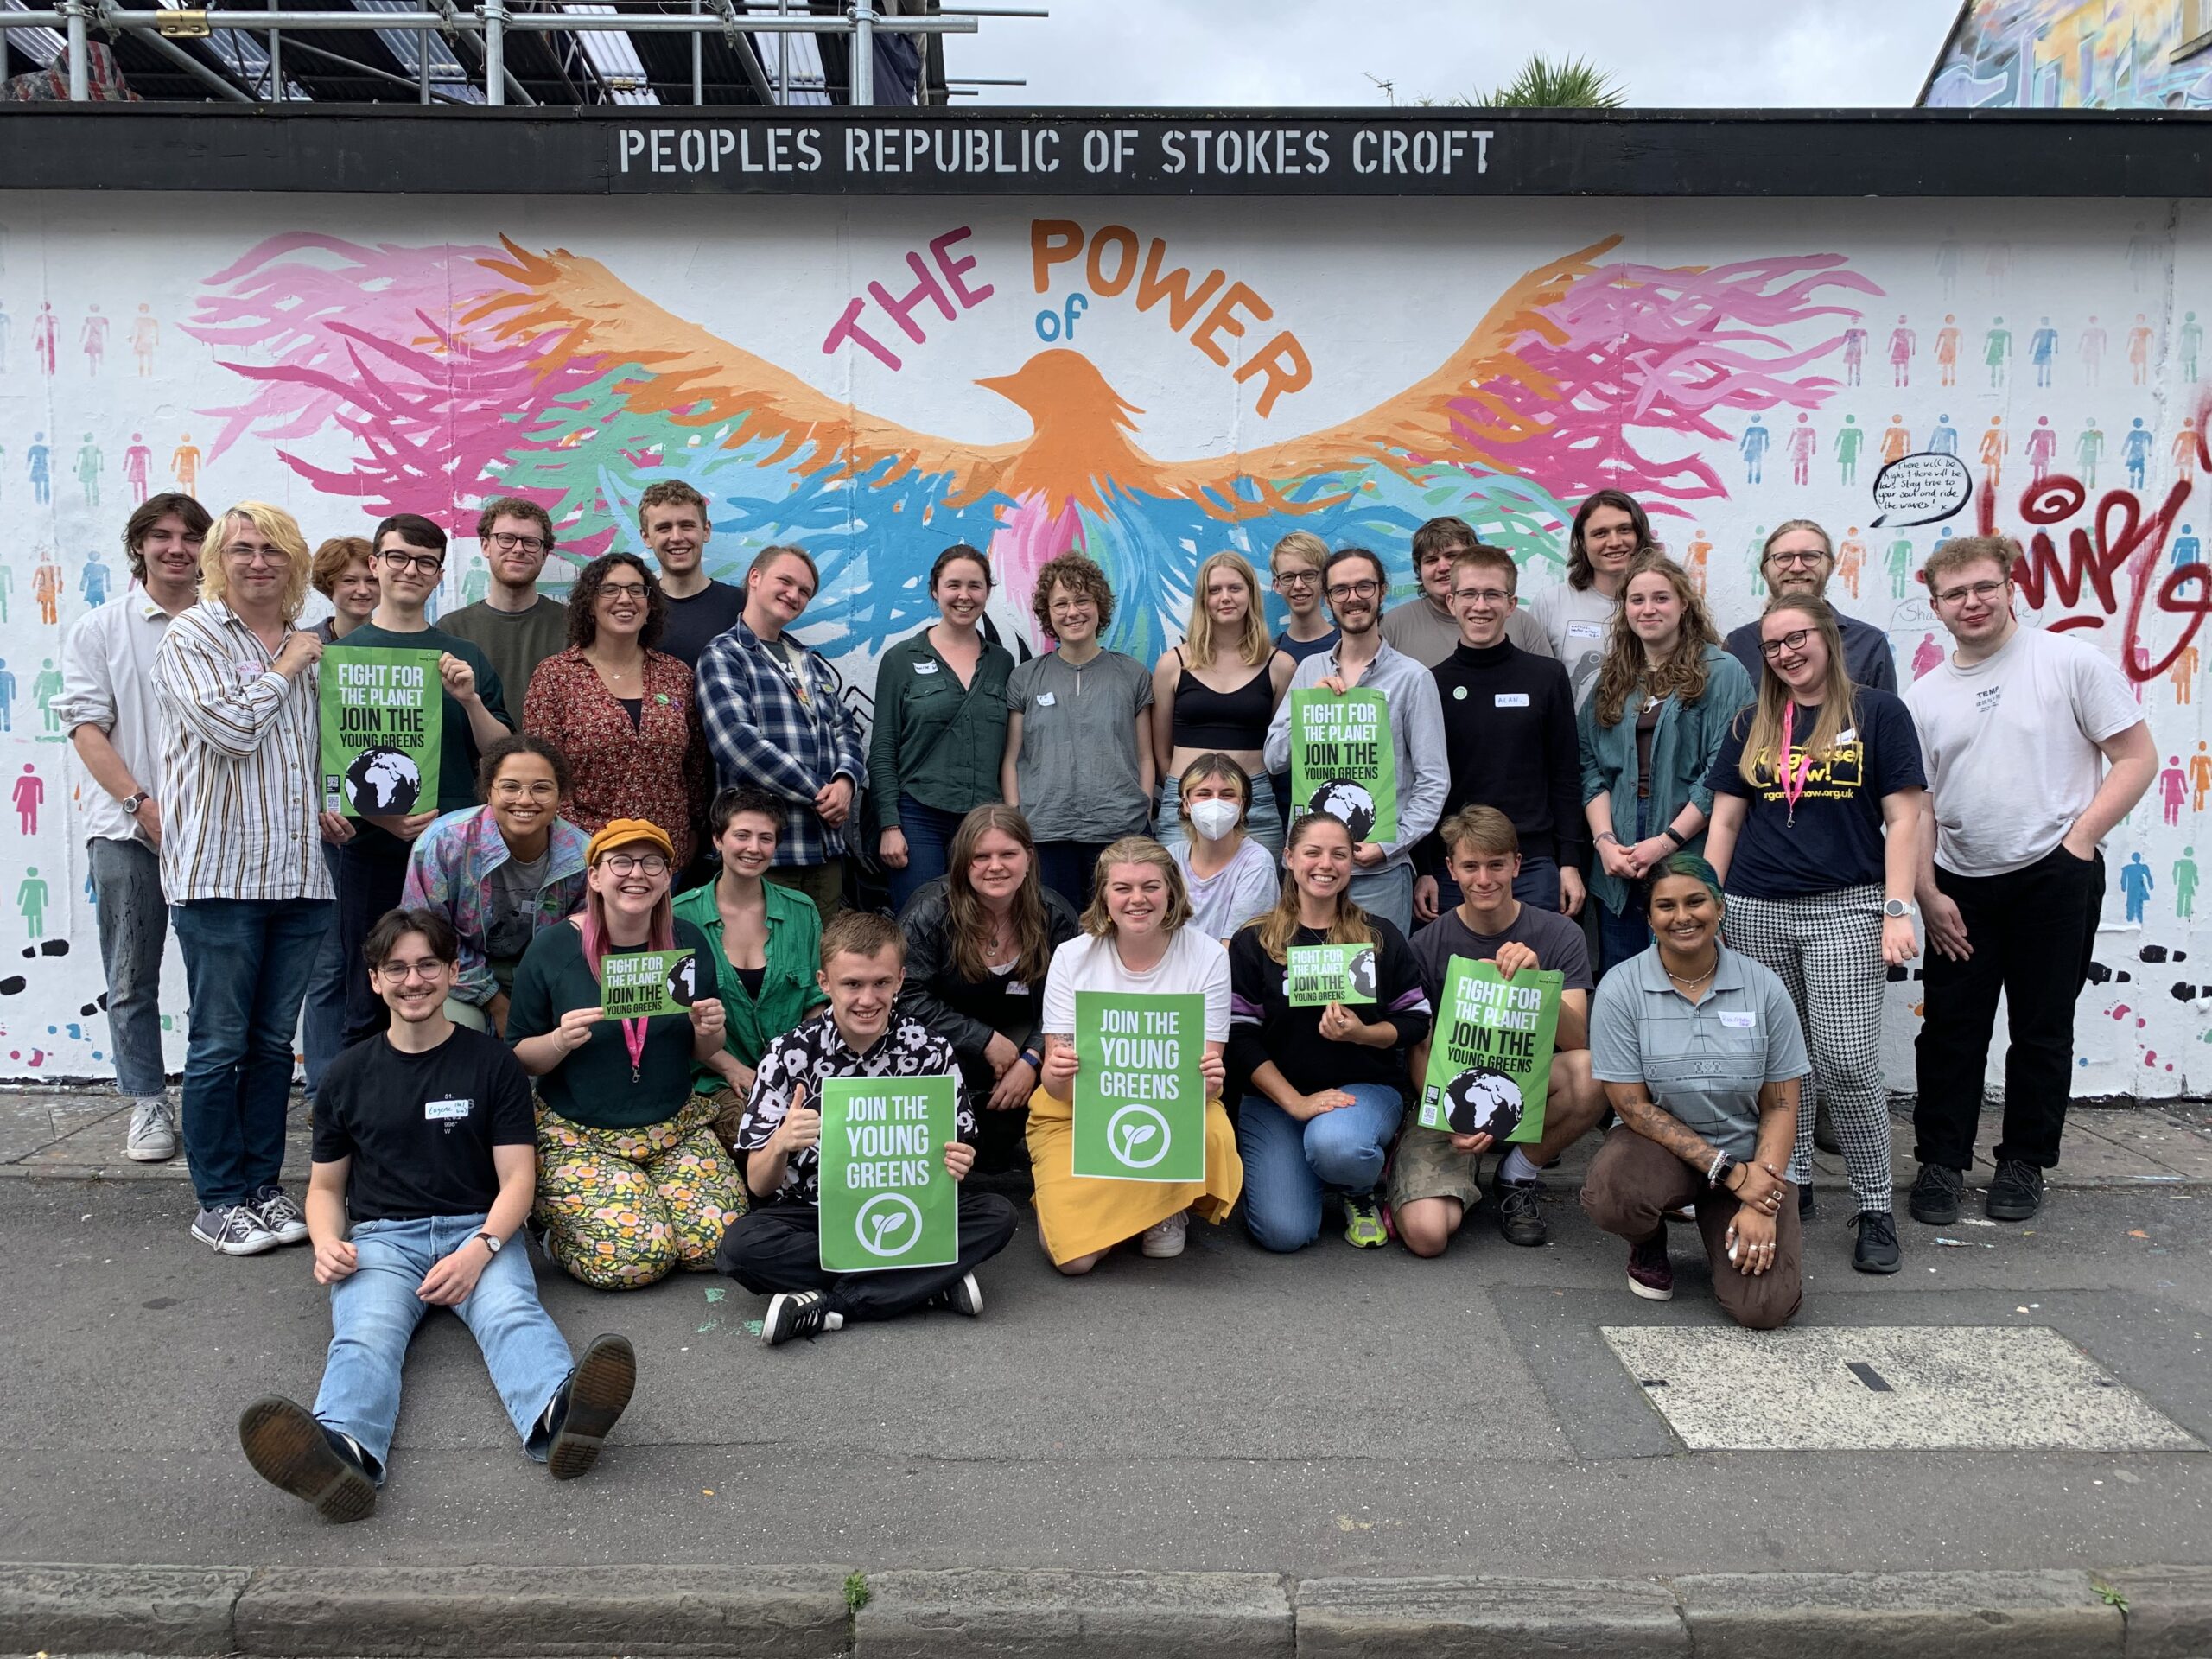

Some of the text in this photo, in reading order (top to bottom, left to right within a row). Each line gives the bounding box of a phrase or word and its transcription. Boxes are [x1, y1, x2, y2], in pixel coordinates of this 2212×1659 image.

[620, 128, 1494, 174] PEOPLES REPUBLIC OF STOKES CROFT
[822, 219, 1313, 420] THE POWER
[1035, 292, 1088, 343] of
[1898, 459, 1957, 469] There will be
[1884, 471, 1904, 482] highs
[1951, 469, 1962, 478] be
[1901, 479, 1921, 492] Stay
[1924, 478, 1941, 486] true
[1878, 487, 1959, 504] your soul and ride
[338, 664, 423, 688] FIGHT FOR
[339, 688, 423, 707] THE PLANET
[340, 707, 424, 733] JOIN THE
[1302, 702, 1377, 724] FIGHT FOR
[339, 734, 424, 748] YOUNG GREENS
[1303, 724, 1377, 742] THE PLANET
[1304, 742, 1378, 766] JOIN THE
[1304, 766, 1379, 780] YOUNG GREENS
[606, 956, 664, 976] FIGHT FOR
[1291, 948, 1344, 964] FIGHT FOR
[607, 971, 663, 988] THE PLANET
[1292, 962, 1344, 976] THE PLANET
[607, 984, 663, 1005] JOIN THE
[1294, 975, 1345, 992] JOIN THE
[1456, 976, 1542, 1011] FIGHT FOR
[1294, 990, 1345, 1002] YOUNG GREENS
[607, 1001, 663, 1015] YOUNG GREENS
[1454, 1000, 1540, 1031] THE PLANET
[1100, 1009, 1180, 1035] JOIN THE
[1448, 1020, 1537, 1058] JOIN THE
[1099, 1037, 1179, 1070] YOUNG
[1447, 1046, 1533, 1073] YOUNG GREENS
[1100, 1071, 1179, 1100] GREENS
[846, 1095, 929, 1122] JOIN THE
[846, 1124, 930, 1158] YOUNG
[846, 1160, 930, 1189] GREENS
